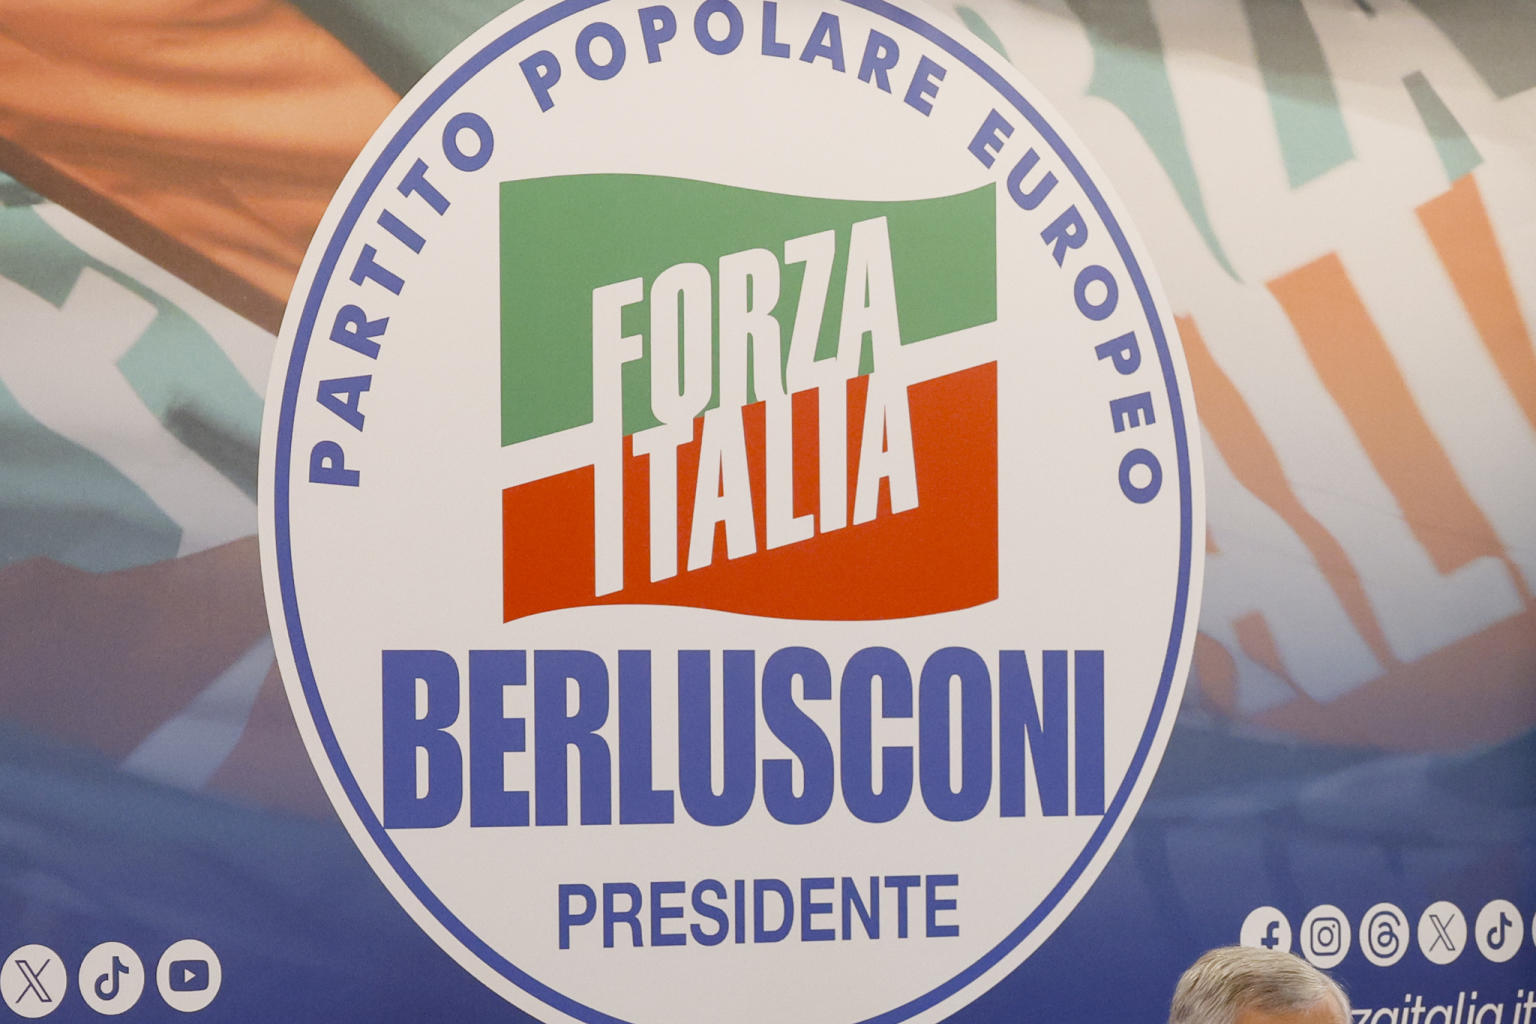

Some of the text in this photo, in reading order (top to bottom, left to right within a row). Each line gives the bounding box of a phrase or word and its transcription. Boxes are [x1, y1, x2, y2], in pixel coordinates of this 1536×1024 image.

[309, 112, 494, 487] PARTITO
[519, 0, 947, 117] POPOLARE
[967, 108, 1163, 504] EUROPEO
[593, 216, 901, 432] FORZA
[595, 372, 919, 597] ITALIA
[381, 646, 1105, 829] BERLUSCONI
[558, 874, 960, 949] PRESIDENTE
